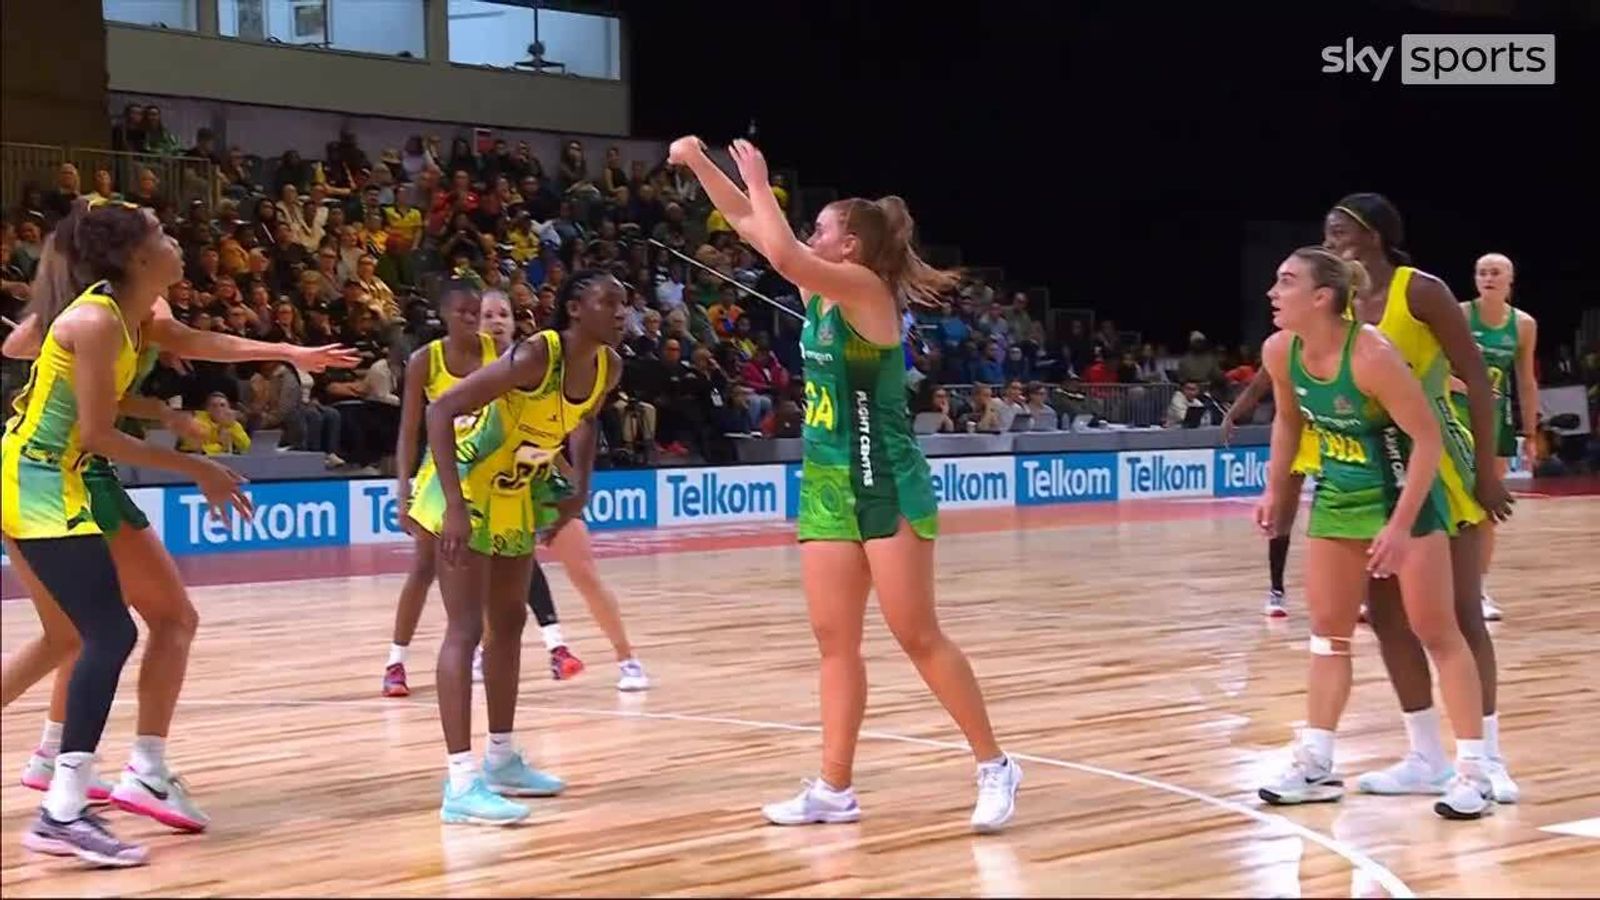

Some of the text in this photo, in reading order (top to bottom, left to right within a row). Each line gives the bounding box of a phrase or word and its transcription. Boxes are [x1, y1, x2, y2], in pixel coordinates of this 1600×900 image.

[856, 390, 870, 434] FLIGHT
[931, 463, 1007, 501] elkom
[1023, 458, 1111, 499] Telkom
[1126, 456, 1207, 493] Telkom
[1220, 451, 1267, 488] Telk
[666, 472, 777, 517] Telkom
[179, 490, 337, 544] Telkom
